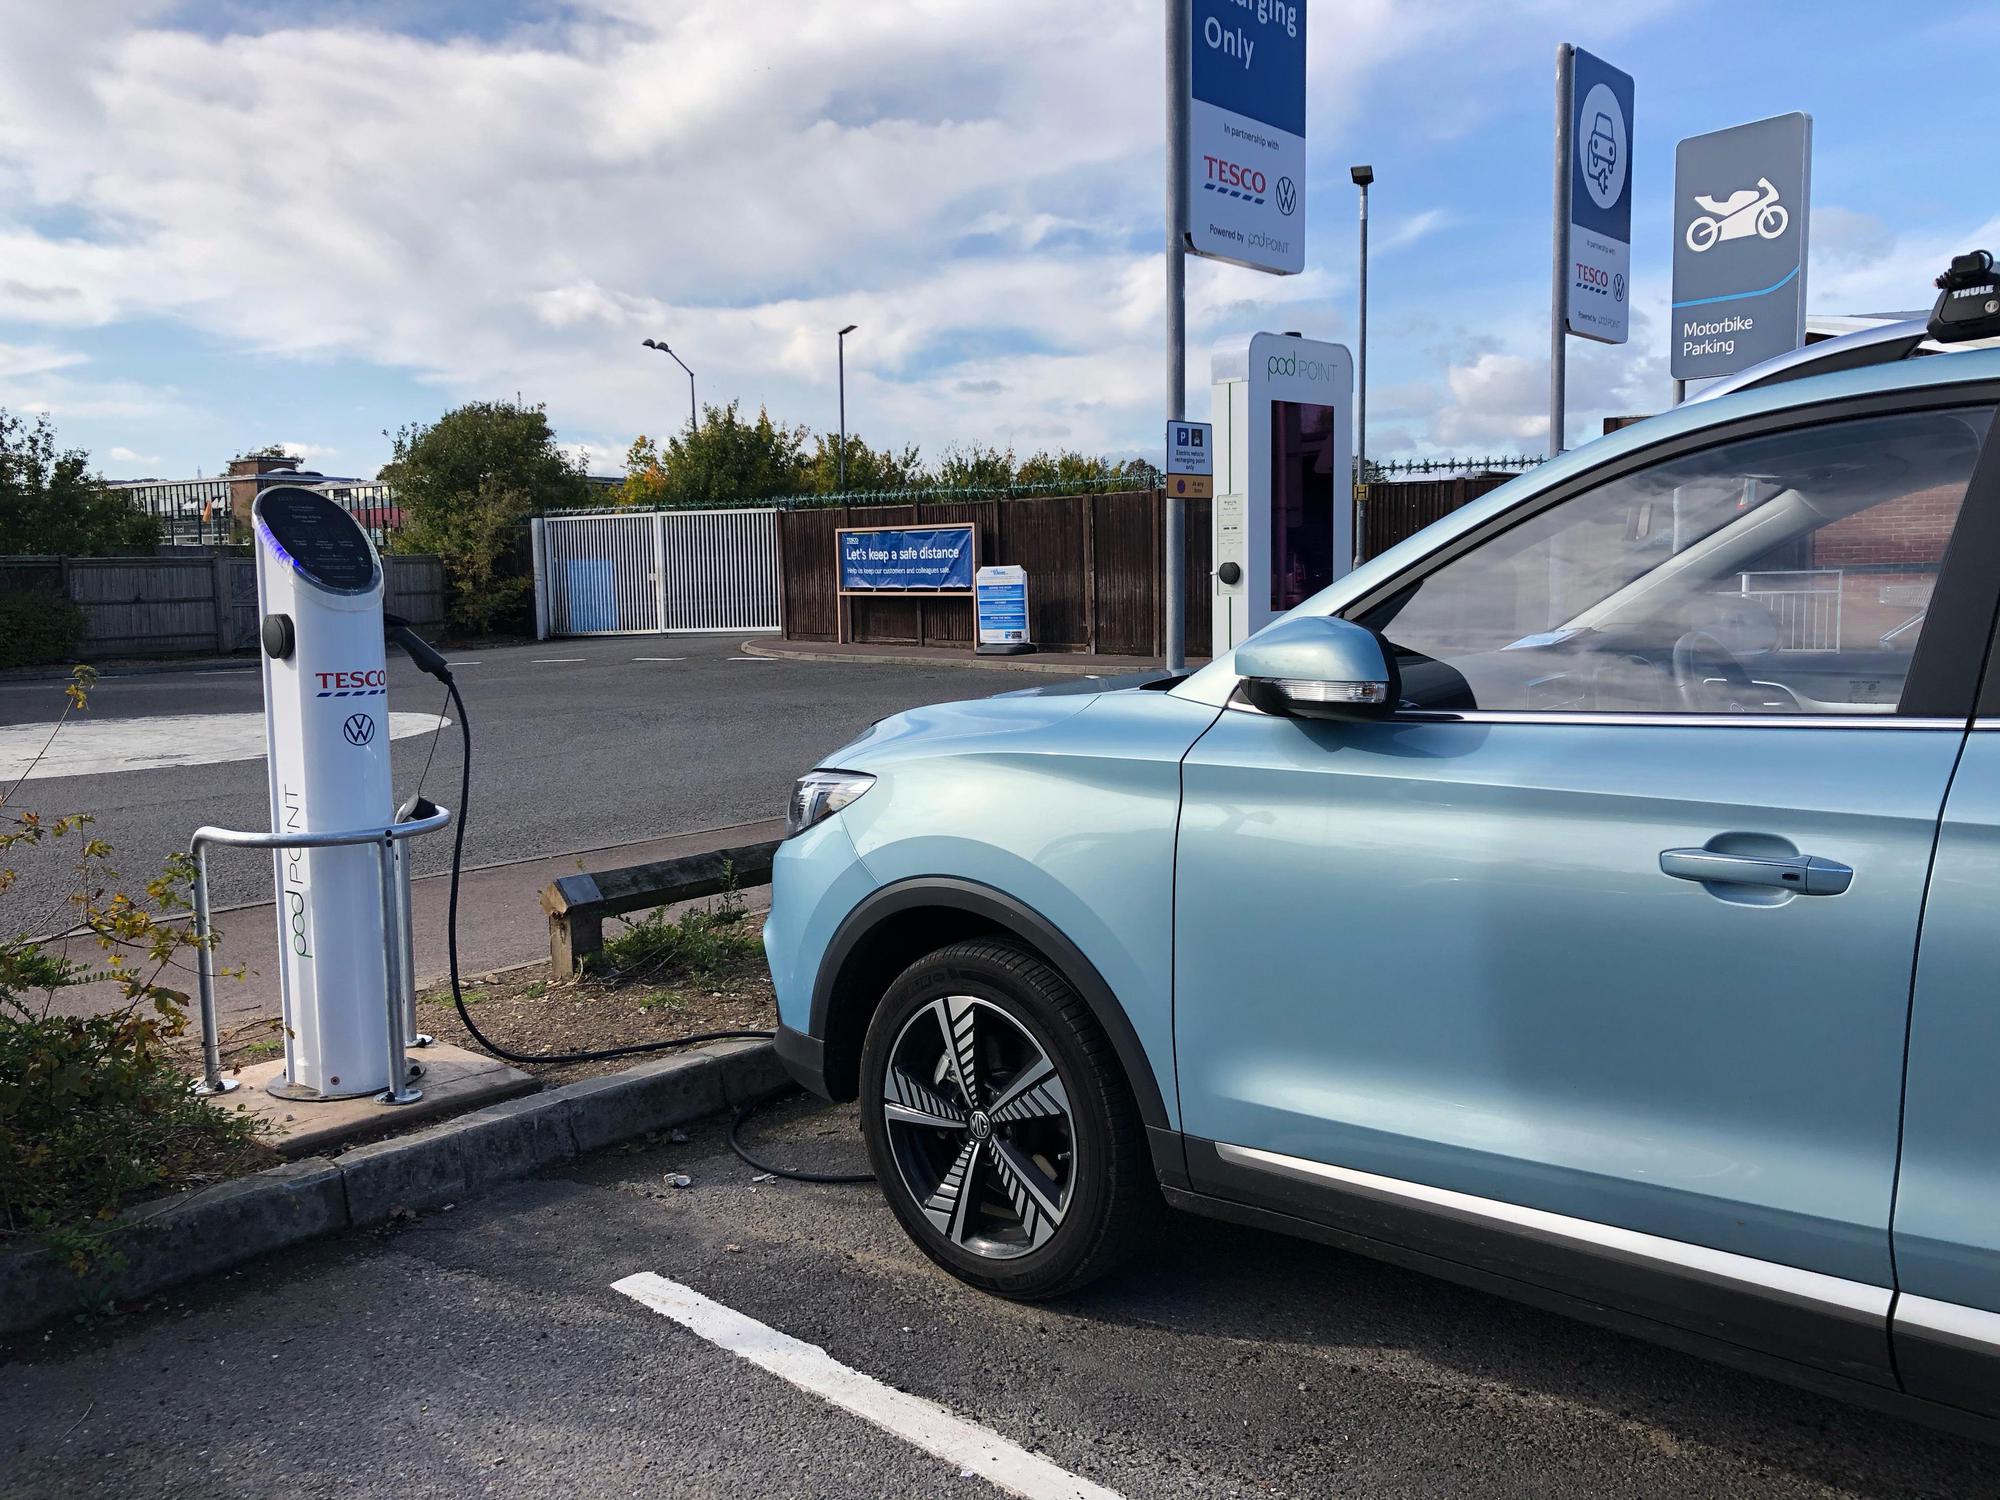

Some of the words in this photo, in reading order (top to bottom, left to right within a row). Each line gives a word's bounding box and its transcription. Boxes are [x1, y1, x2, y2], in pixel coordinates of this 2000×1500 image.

[1204, 16, 1254, 70] Only
[1223, 122, 1231, 134] In
[1231, 127, 1266, 146] partnership
[1267, 140, 1280, 151] with
[1204, 155, 1266, 194] TESCO
[1209, 223, 1236, 240] Powered
[1236, 230, 1244, 244] by
[1576, 263, 1608, 287] TESCO
[1952, 285, 1994, 299] THULE
[1683, 316, 1753, 338] Motorbike
[1683, 339, 1735, 356] Parking
[1180, 431, 1186, 443] P
[1356, 486, 1367, 499] H
[846, 547, 867, 560] Let's
[868, 548, 889, 563] keep
[891, 550, 898, 560] a
[899, 547, 918, 559] safe
[919, 546, 959, 559] distance
[864, 567, 875, 575] keep
[915, 567, 939, 575] colleagues
[315, 670, 386, 689] TESCO
